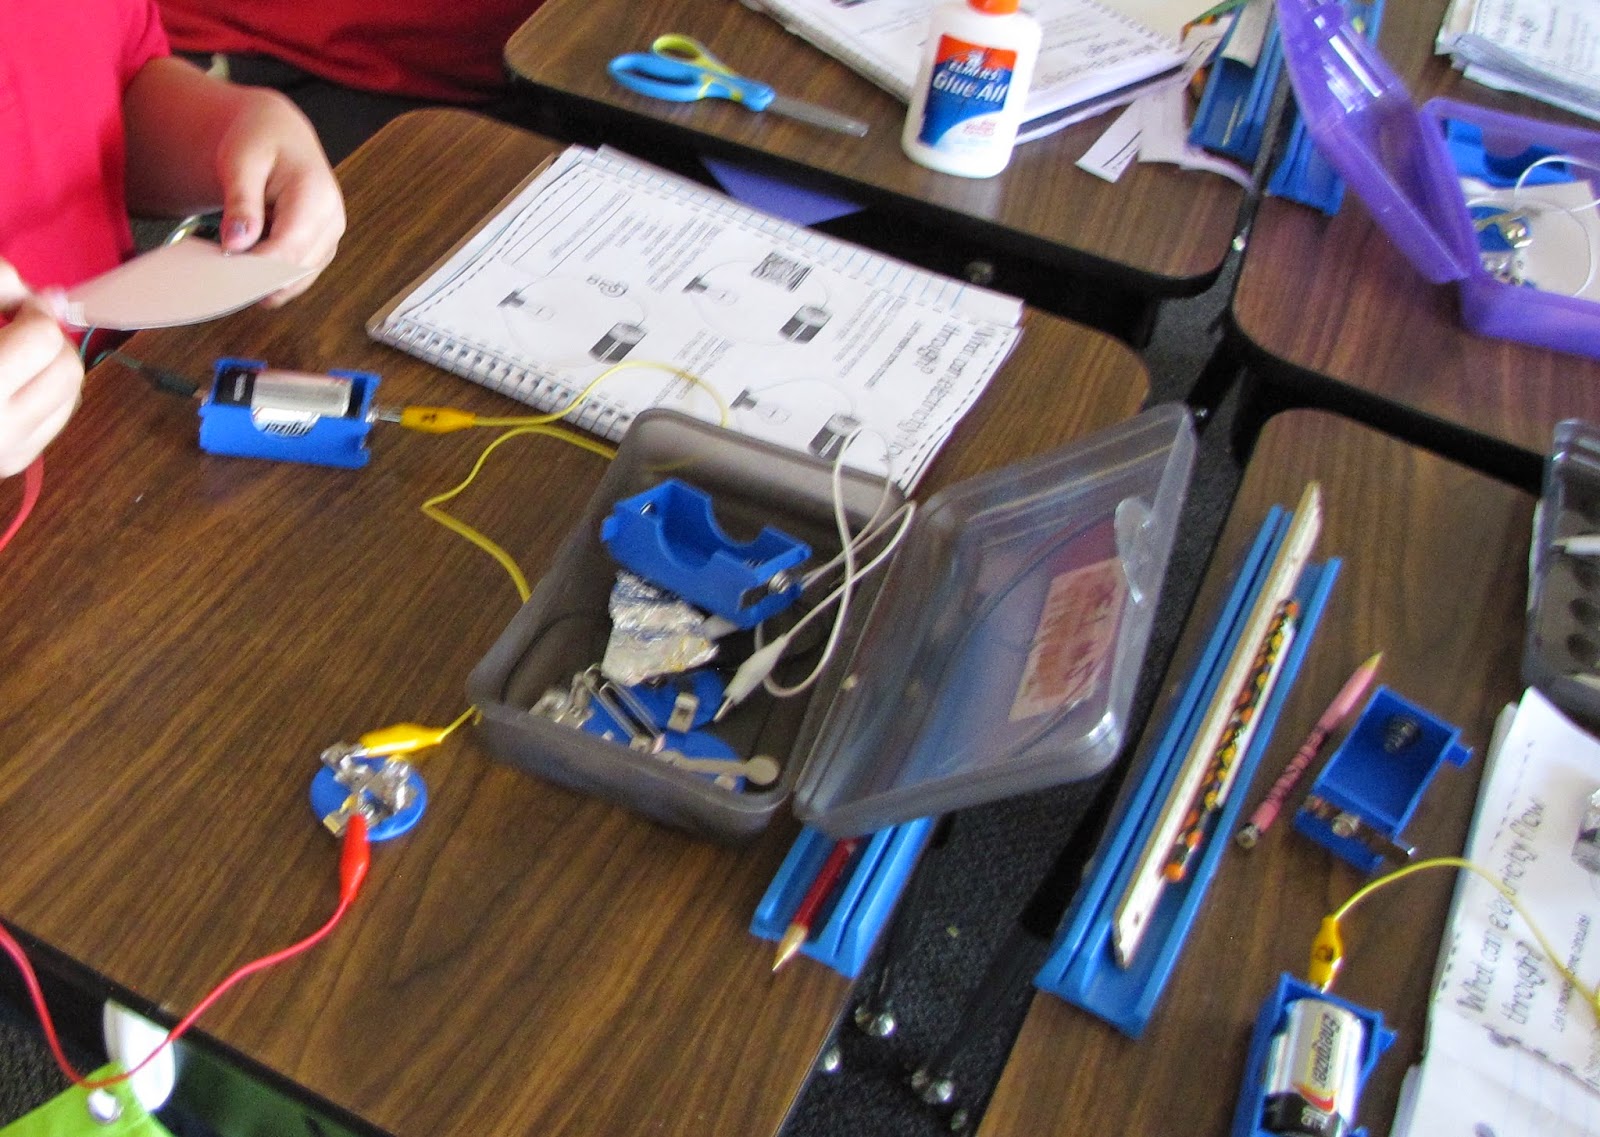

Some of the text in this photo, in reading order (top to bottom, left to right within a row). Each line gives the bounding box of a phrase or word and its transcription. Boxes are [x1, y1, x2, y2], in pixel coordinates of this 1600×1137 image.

[932, 71, 1008, 103] Glue All
[1457, 964, 1493, 1013] What
[1483, 930, 1502, 963] can
[1509, 800, 1546, 841] flow
[1501, 940, 1546, 1025] through?
[1312, 1013, 1341, 1088] Energizer
